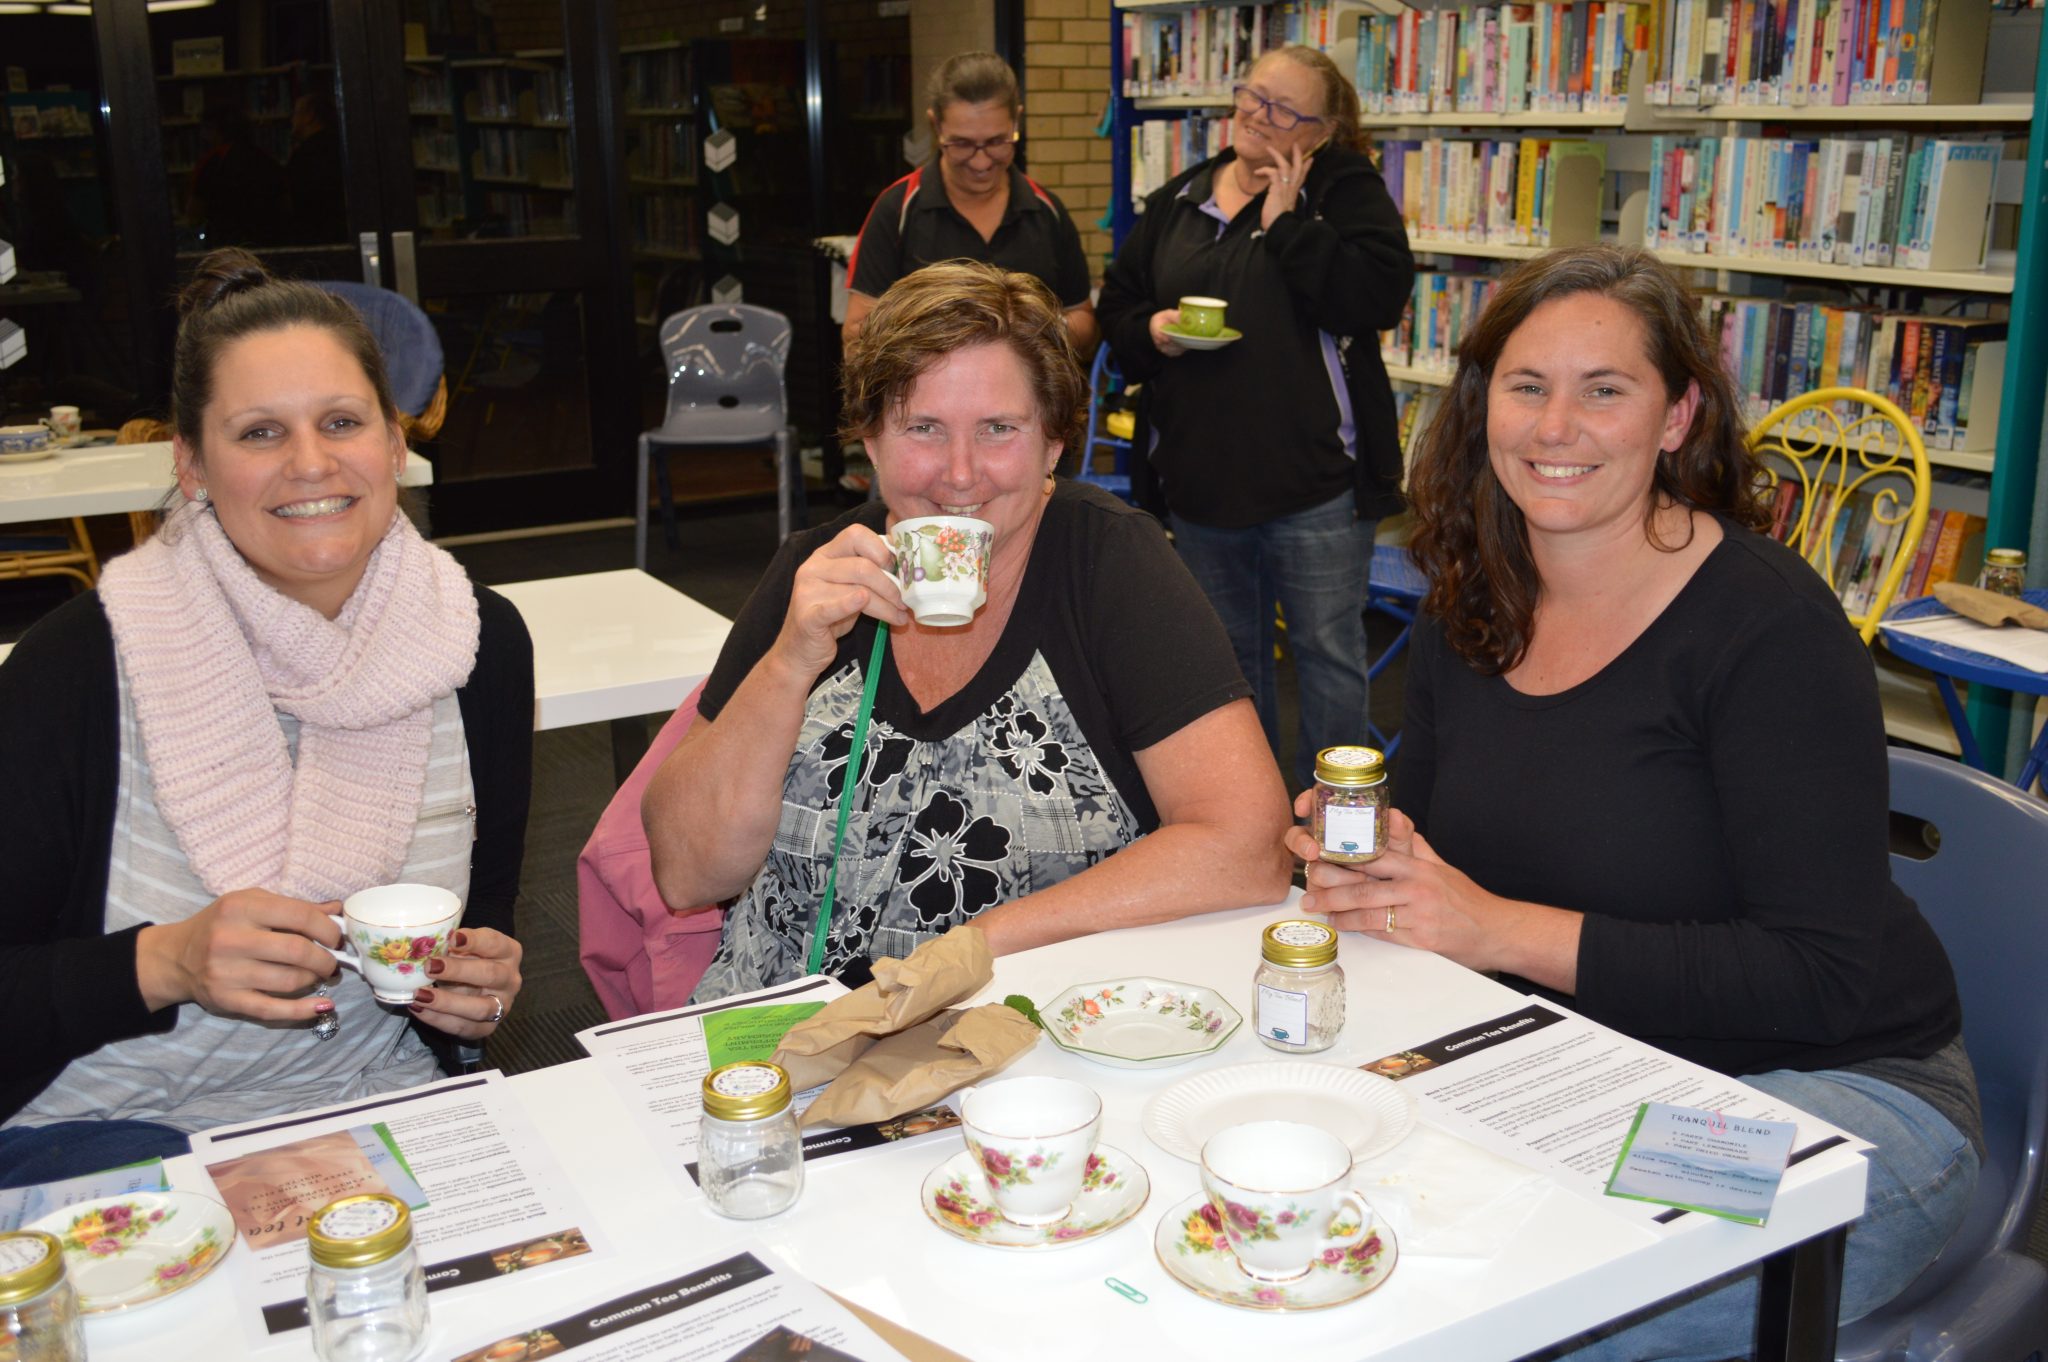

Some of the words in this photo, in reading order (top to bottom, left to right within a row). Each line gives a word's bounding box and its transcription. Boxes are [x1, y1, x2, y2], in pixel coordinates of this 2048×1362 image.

[1935, 330, 1945, 356] PETER
[1932, 358, 1942, 384] WATT
[1445, 1036, 1485, 1051] Common
[1482, 1030, 1502, 1038] Tea
[1499, 1018, 1536, 1032] Benefits
[1734, 1125, 1771, 1136] BLEND
[1707, 1137, 1747, 1148] CHAMOMILE
[248, 1220, 285, 1237] tea
[426, 1266, 460, 1282] Com
[589, 1302, 652, 1328] Common
[651, 1293, 678, 1306] Tea
[678, 1273, 732, 1296] Benefits
